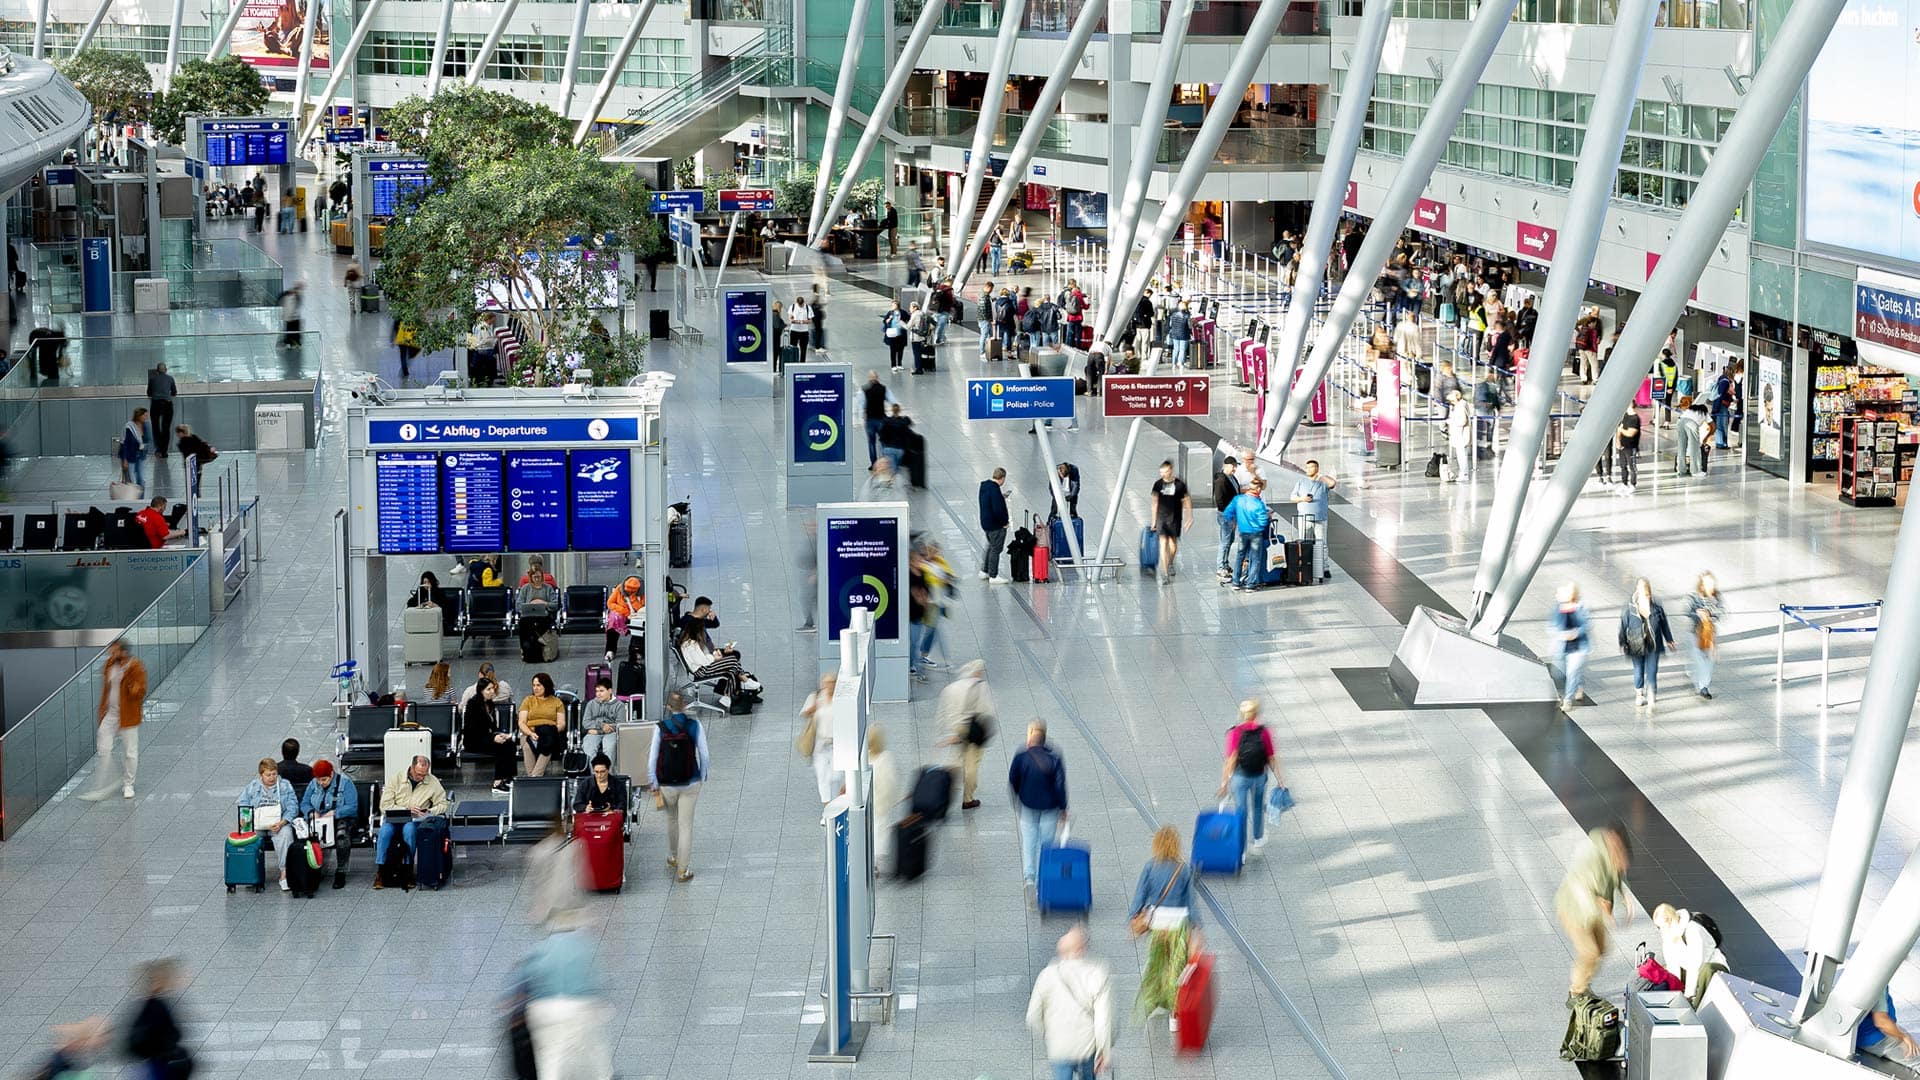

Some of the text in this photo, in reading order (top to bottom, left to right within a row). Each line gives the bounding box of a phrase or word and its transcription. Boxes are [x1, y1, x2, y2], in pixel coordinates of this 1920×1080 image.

[90, 249, 100, 260] B
[1878, 293, 1904, 315] Gates
[1877, 321, 1895, 339] Shops
[1813, 329, 1840, 349] WHSmith
[1006, 384, 1047, 392] Information
[1136, 382, 1173, 390] Restaurants
[1006, 400, 1030, 408] Polizei
[1033, 399, 1056, 408] Police
[442, 424, 548, 439] Abflug Departures
[809, 428, 832, 437] 59 %
[127, 555, 178, 564] Servicepunkt
[160, 564, 178, 572] point
[848, 594, 879, 604] 59 %
